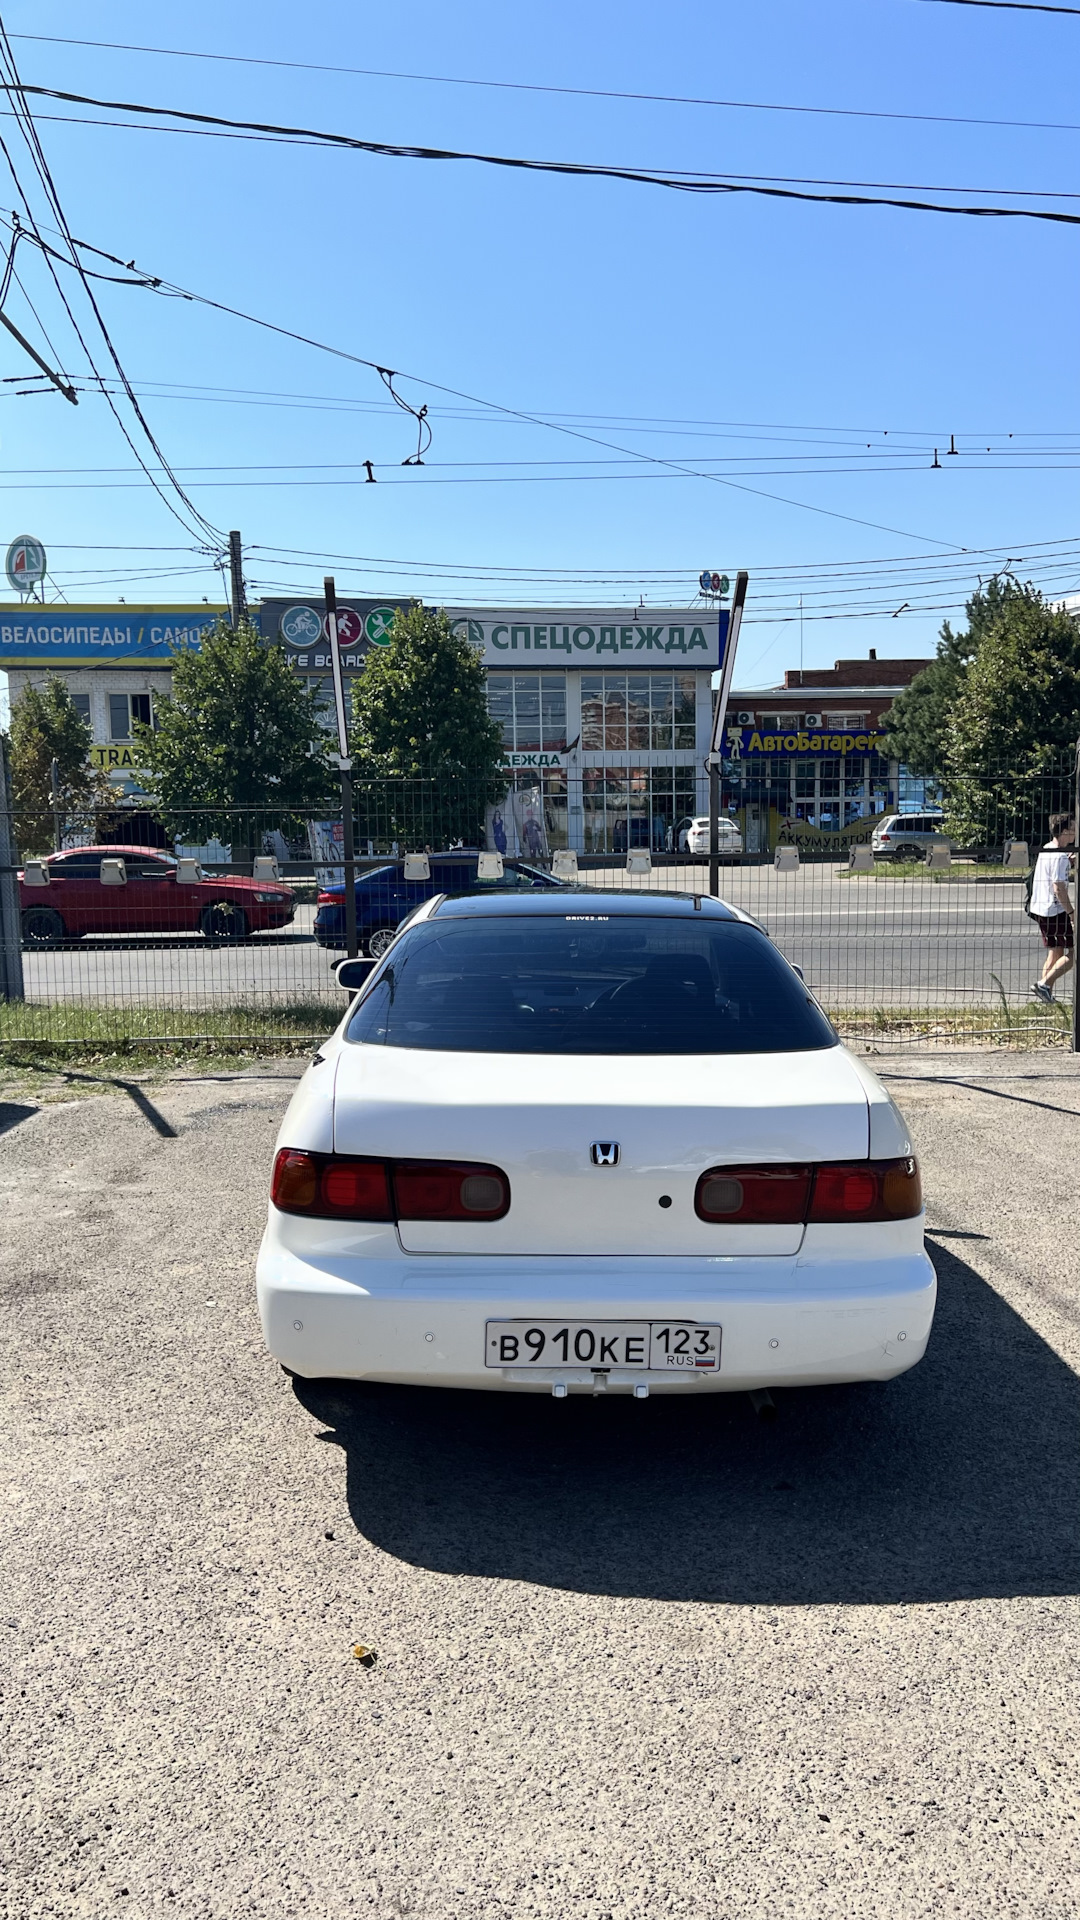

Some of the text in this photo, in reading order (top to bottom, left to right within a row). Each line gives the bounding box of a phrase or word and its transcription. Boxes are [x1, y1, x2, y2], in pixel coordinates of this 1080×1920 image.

[1, 626, 131, 646] ВЕЛОСИПЕДЫ
[491, 625, 708, 654] СПЕЦОДЕЖДА
[500, 1328, 710, 1363] В910КЕ 123
[666, 1355, 694, 1366] RUS
